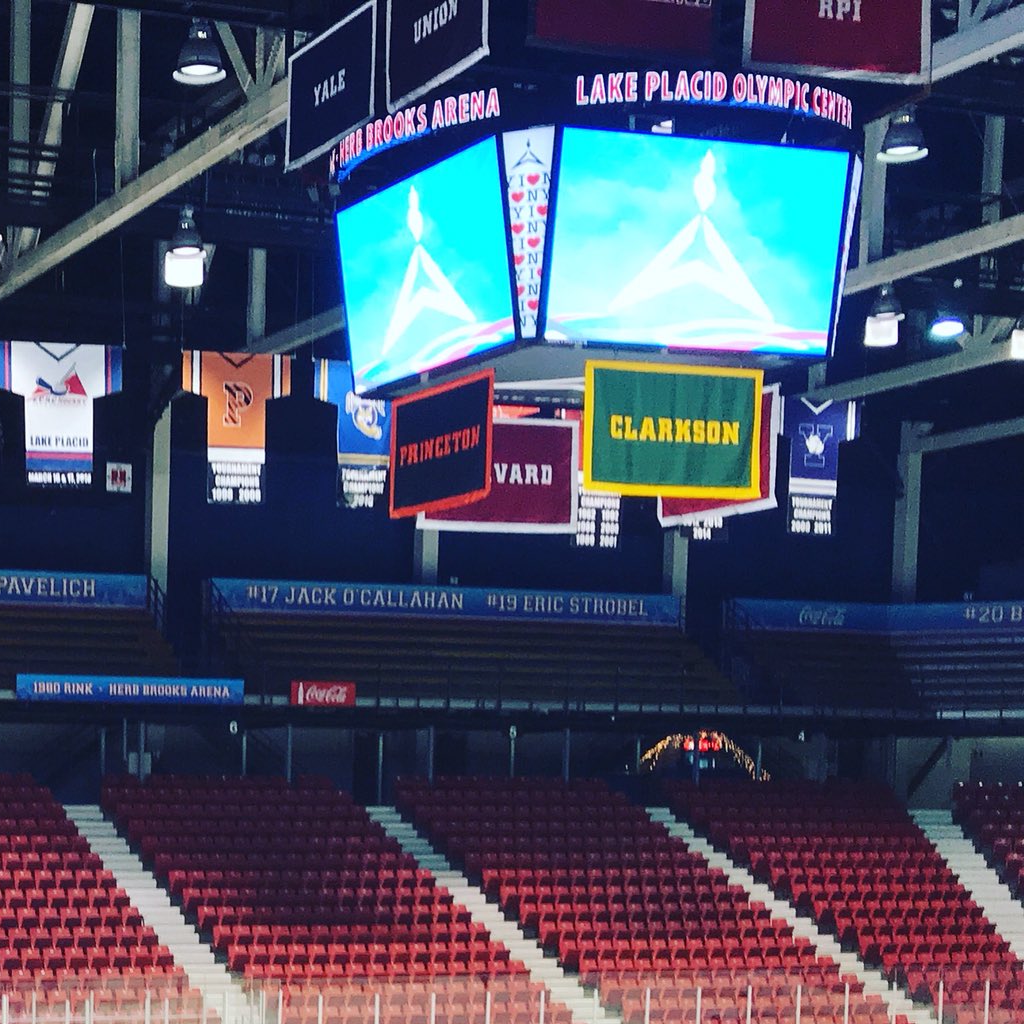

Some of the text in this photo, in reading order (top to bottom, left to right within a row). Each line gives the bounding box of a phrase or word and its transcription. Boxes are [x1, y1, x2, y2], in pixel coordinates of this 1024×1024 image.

[413, 0, 458, 44] UNION
[818, 0, 861, 22] RPI
[313, 68, 346, 107] YALE
[576, 70, 853, 129] LAKE PLACID OLYMPIC CENTER
[340, 88, 501, 168] HERB BROOKS ARENA
[610, 414, 740, 445] CLARKSON
[30, 436, 89, 448] LAKE PLACID
[399, 424, 481, 466] PRINCETON
[215, 474, 260, 488] CHAMPIONS
[489, 463, 553, 485] VARD
[246, 585, 464, 610] #17 JACK O'CALLAHAN
[487, 593, 648, 617] #19 ERIC STROBEL
[962, 605, 1004, 623] #20
[64, 682, 94, 695] RINK
[109, 683, 140, 696] HERB
[142, 684, 187, 697] BROOKS
[190, 685, 230, 698] ARENA
